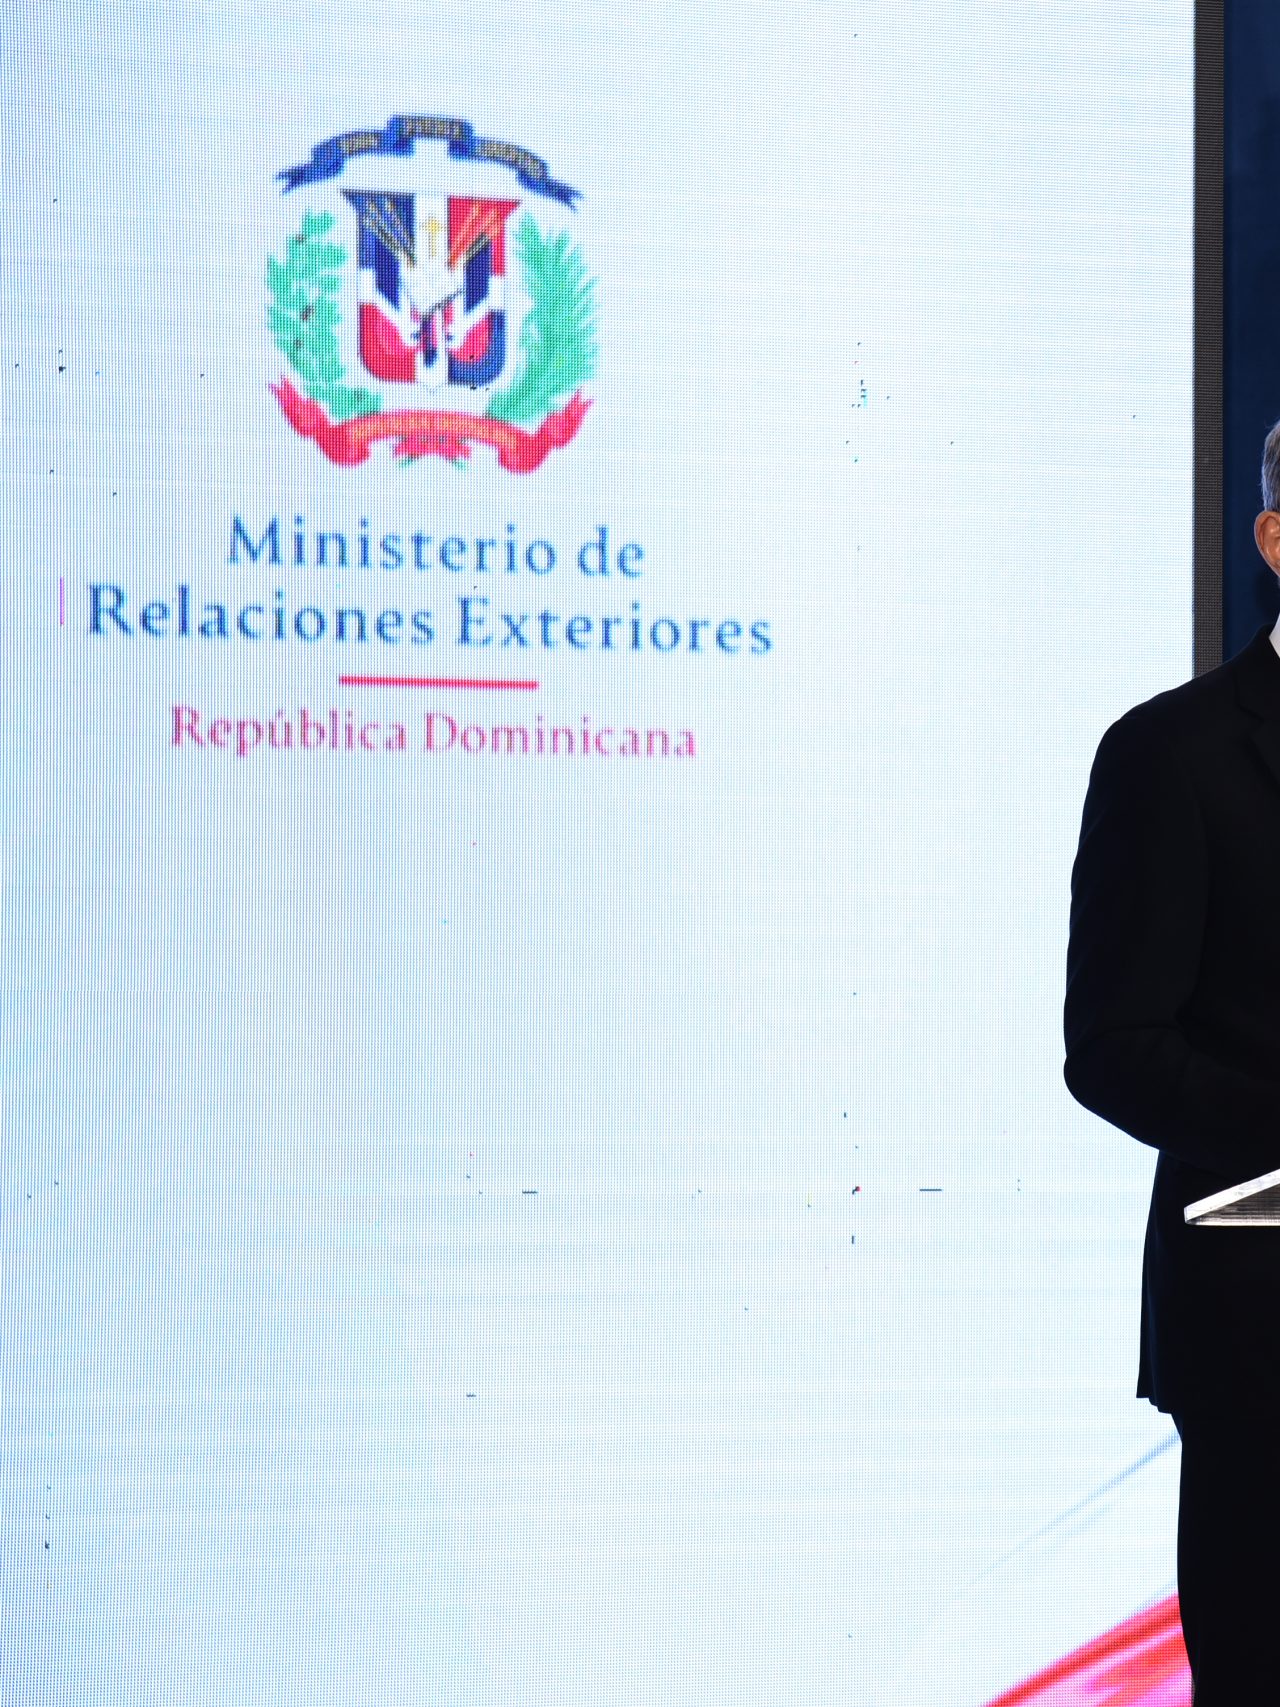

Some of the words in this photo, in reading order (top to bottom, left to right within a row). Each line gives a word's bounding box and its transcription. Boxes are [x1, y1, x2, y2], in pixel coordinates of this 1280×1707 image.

[229, 515, 557, 574] Ministerio
[577, 525, 644, 578] de
[89, 584, 434, 643] Relaciones
[457, 596, 772, 653] Exteriores
[172, 706, 406, 757] República
[425, 713, 695, 756] Dominicana
